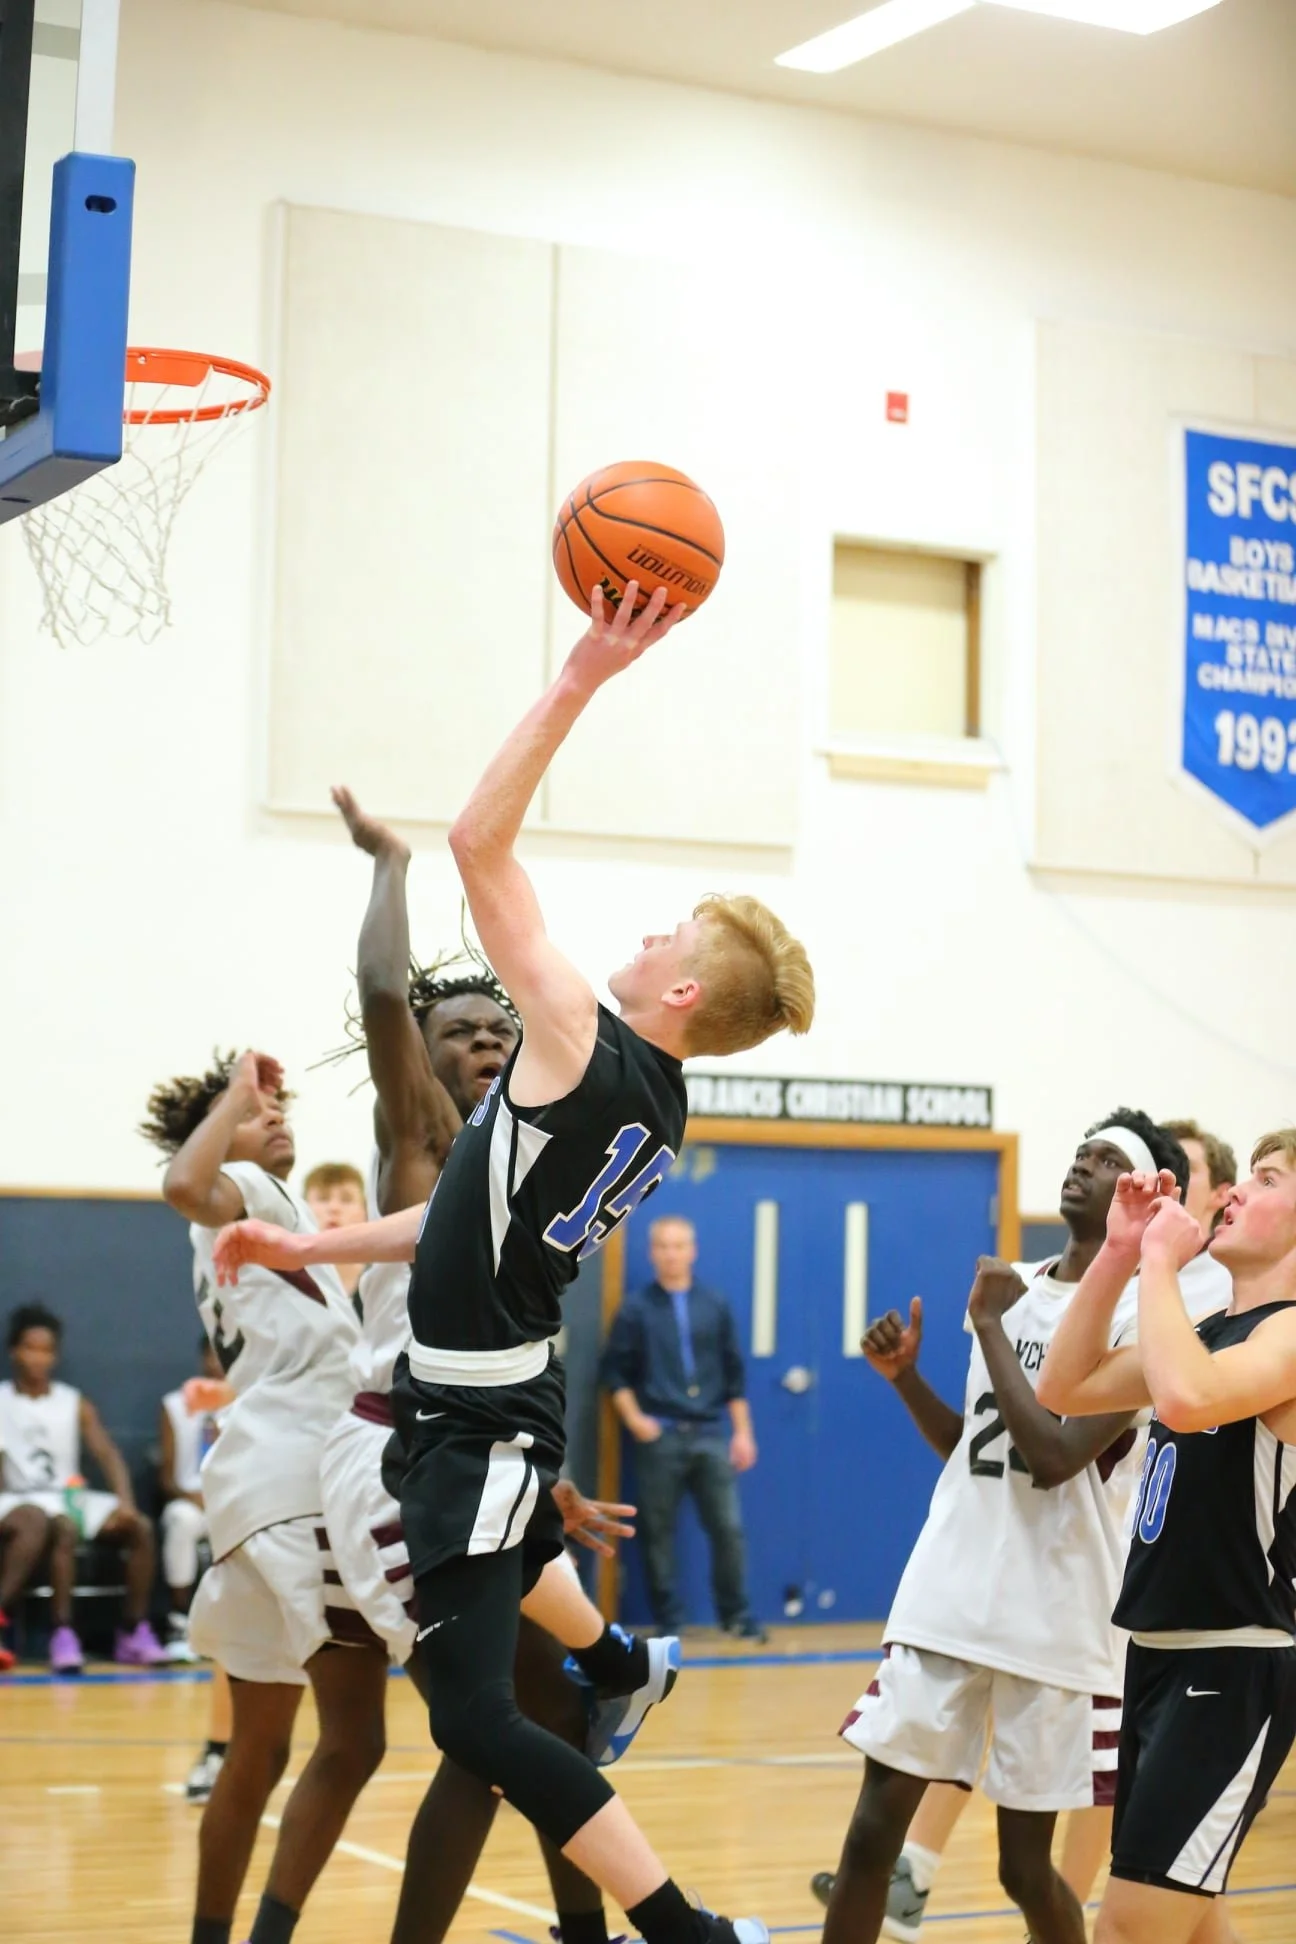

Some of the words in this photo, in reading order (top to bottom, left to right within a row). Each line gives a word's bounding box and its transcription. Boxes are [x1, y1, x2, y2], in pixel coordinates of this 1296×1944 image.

[1207, 461, 1296, 526] SFC
[1229, 534, 1294, 573] BOYS
[786, 1080, 902, 1122] CHRISTIAN
[905, 1085, 990, 1127] SCHOOL
[542, 1122, 677, 1262] 15
